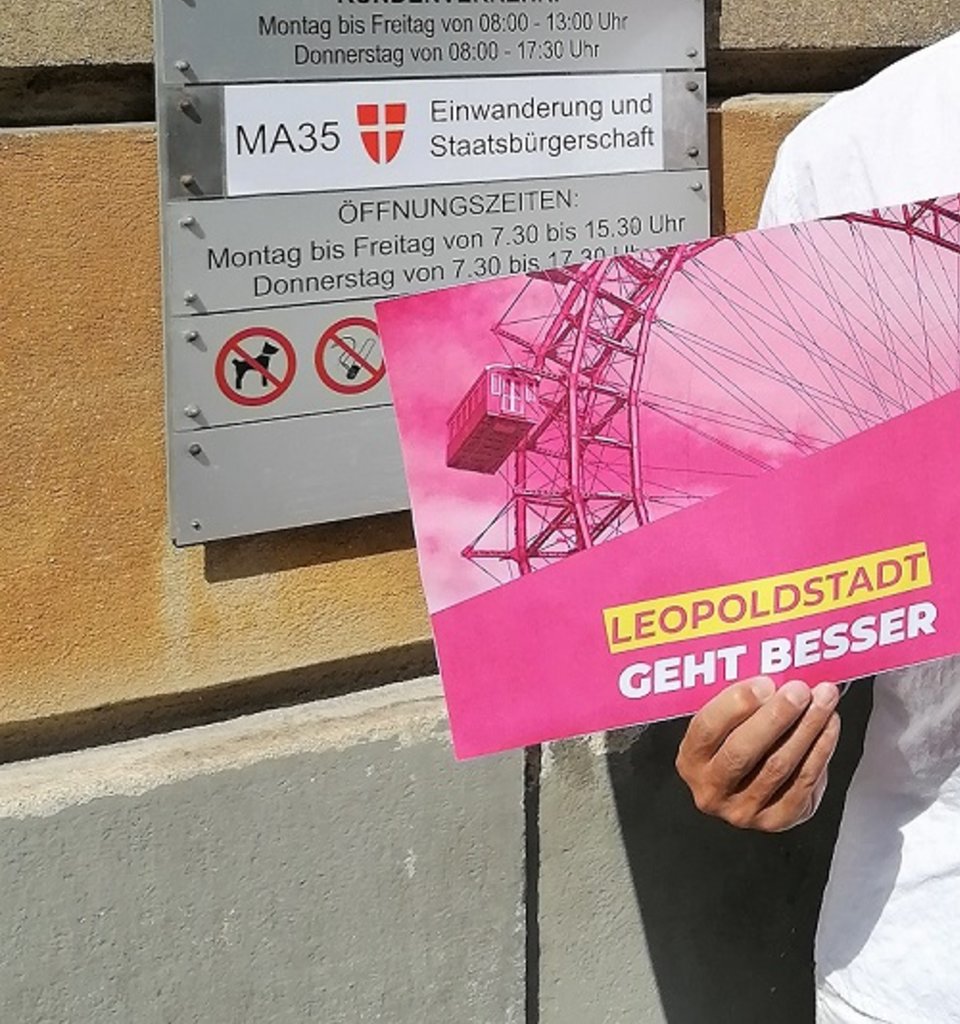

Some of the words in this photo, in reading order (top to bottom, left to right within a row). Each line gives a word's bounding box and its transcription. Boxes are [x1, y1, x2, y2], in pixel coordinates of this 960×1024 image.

[258, 16, 331, 39] Montag
[338, 14, 365, 35] bis
[372, 13, 435, 38] Freitag
[440, 17, 474, 33] von
[479, 12, 529, 32] 08:00
[547, 11, 593, 31] 13:00
[598, 11, 628, 31] Uhr
[294, 43, 404, 67] Donnerstag
[410, 45, 443, 61] von
[448, 40, 499, 61] 08:00
[518, 40, 564, 60] 17:30
[569, 40, 599, 59] Uhr
[431, 96, 603, 123] Einwanderung
[611, 93, 654, 115] und
[235, 121, 341, 155] MA35
[430, 127, 655, 160] Staatsbürgerschaft
[338, 189, 580, 225] ÖFFNUNGSZEITEN:
[207, 240, 302, 270] Montag
[311, 236, 345, 263] bis
[353, 229, 435, 259] Freitag
[442, 233, 483, 253] von
[491, 224, 539, 249] 7.30
[546, 219, 577, 243] bis
[585, 215, 643, 239] 15.30
[648, 212, 686, 234] Uhr
[254, 262, 395, 297] Donnerstag
[402, 262, 445, 284] von
[453, 254, 500, 279] 7.30
[508, 251, 540, 274] bis
[548, 246, 606, 267] 1730
[609, 551, 926, 647] LEOPOLDSTADT
[617, 644, 748, 699] GEHT
[760, 600, 939, 676] BESSER
